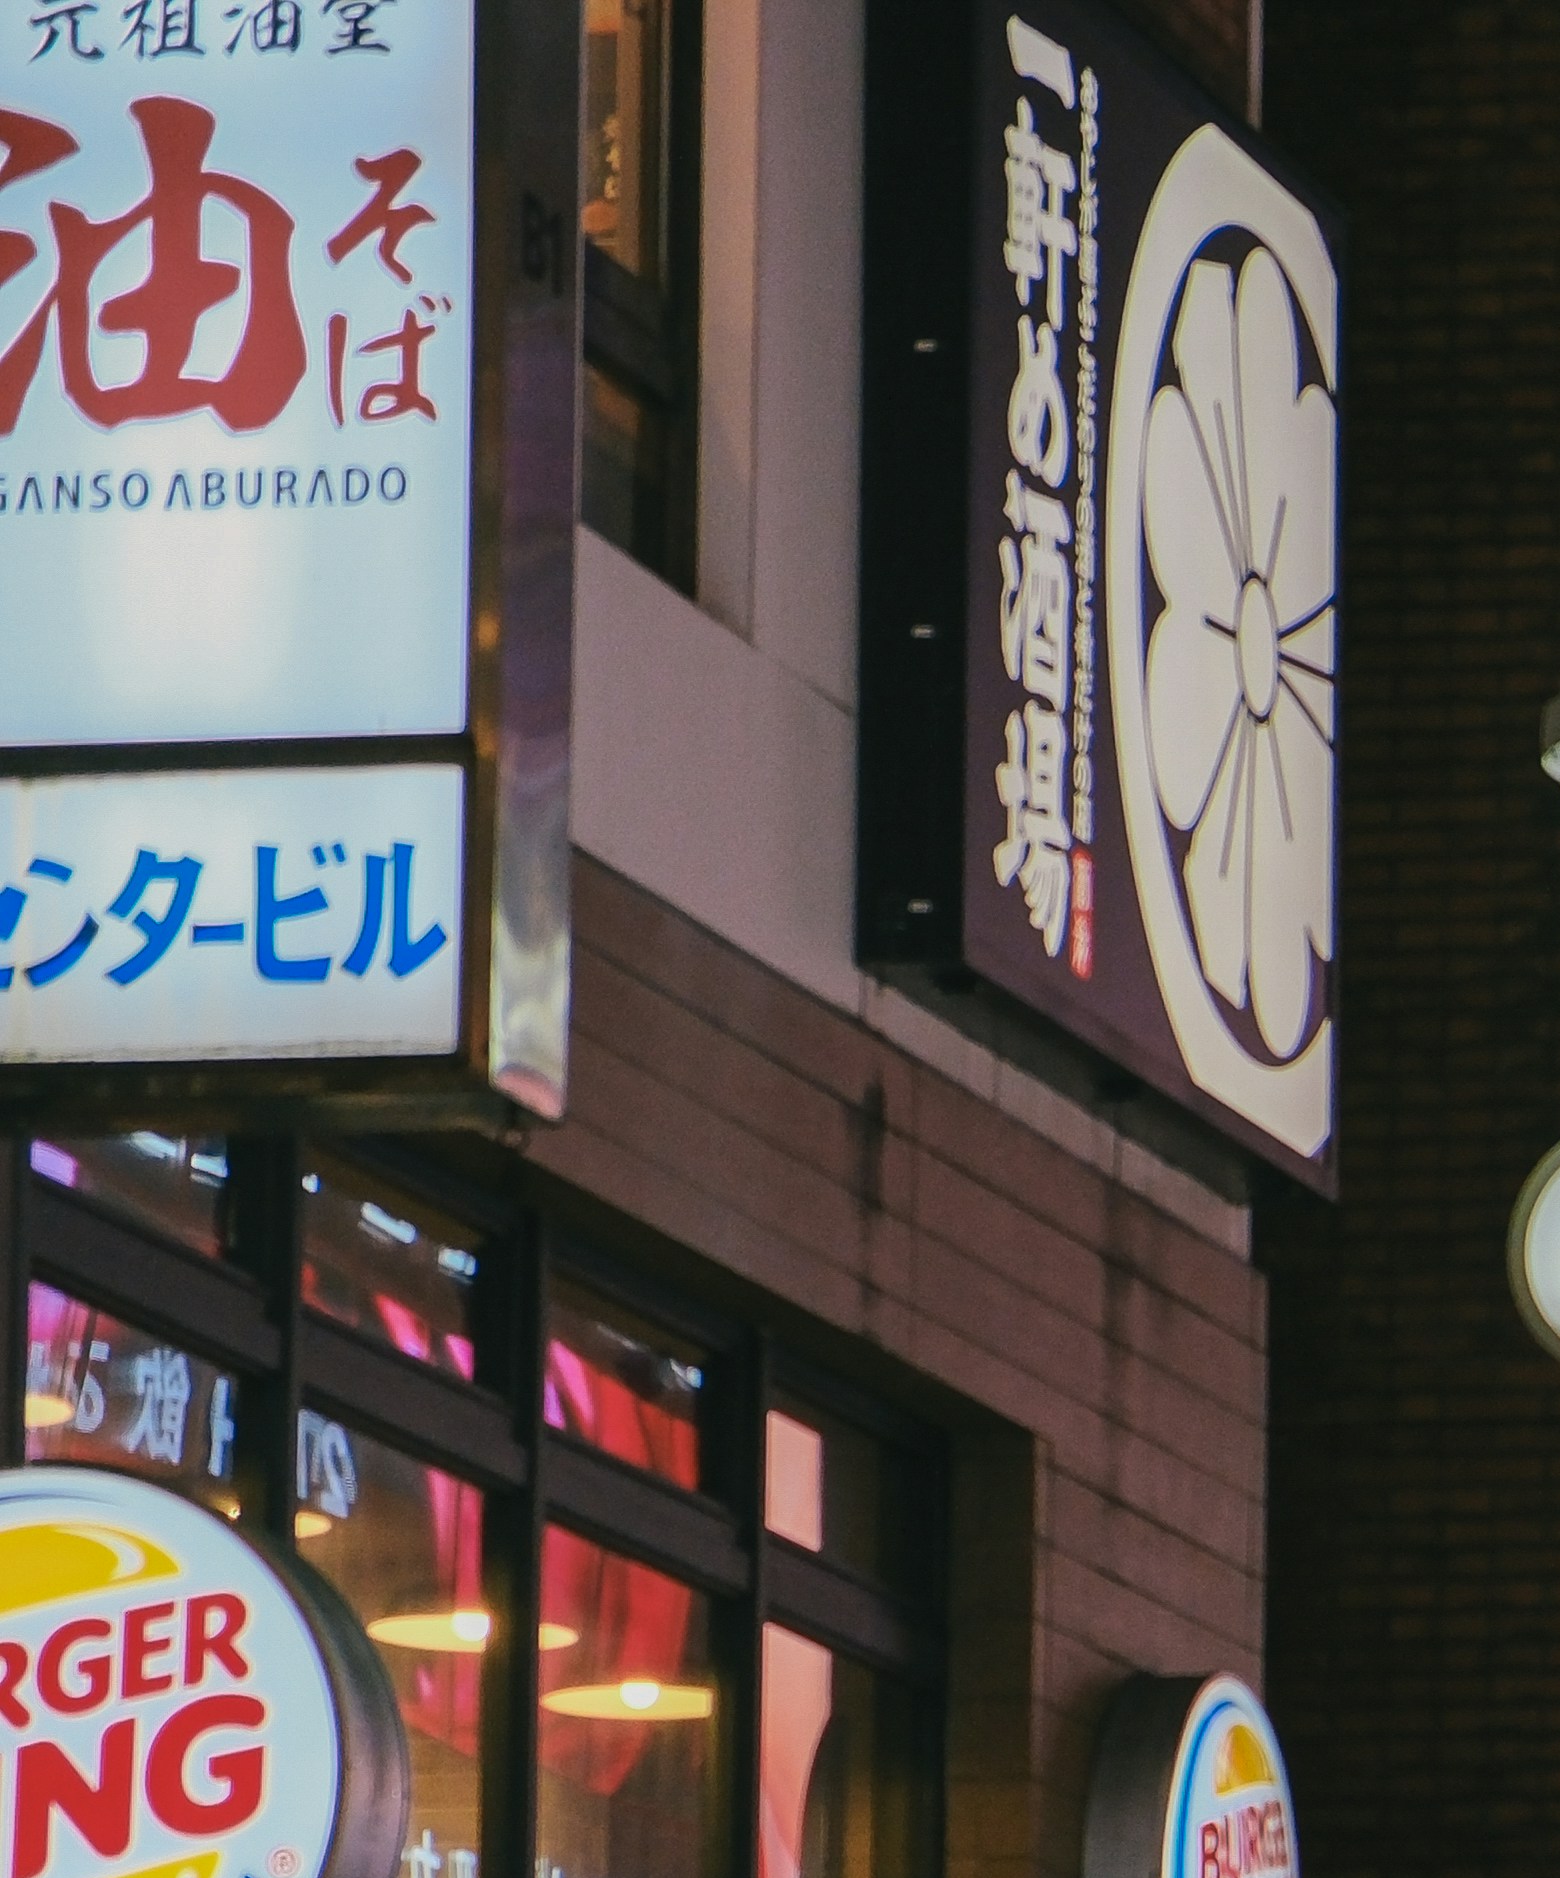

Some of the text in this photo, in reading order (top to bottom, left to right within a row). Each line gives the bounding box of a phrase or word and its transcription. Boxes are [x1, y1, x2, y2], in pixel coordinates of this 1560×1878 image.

[326, 147, 453, 429] そば
[0, 465, 409, 514] ANSO ABURADO
